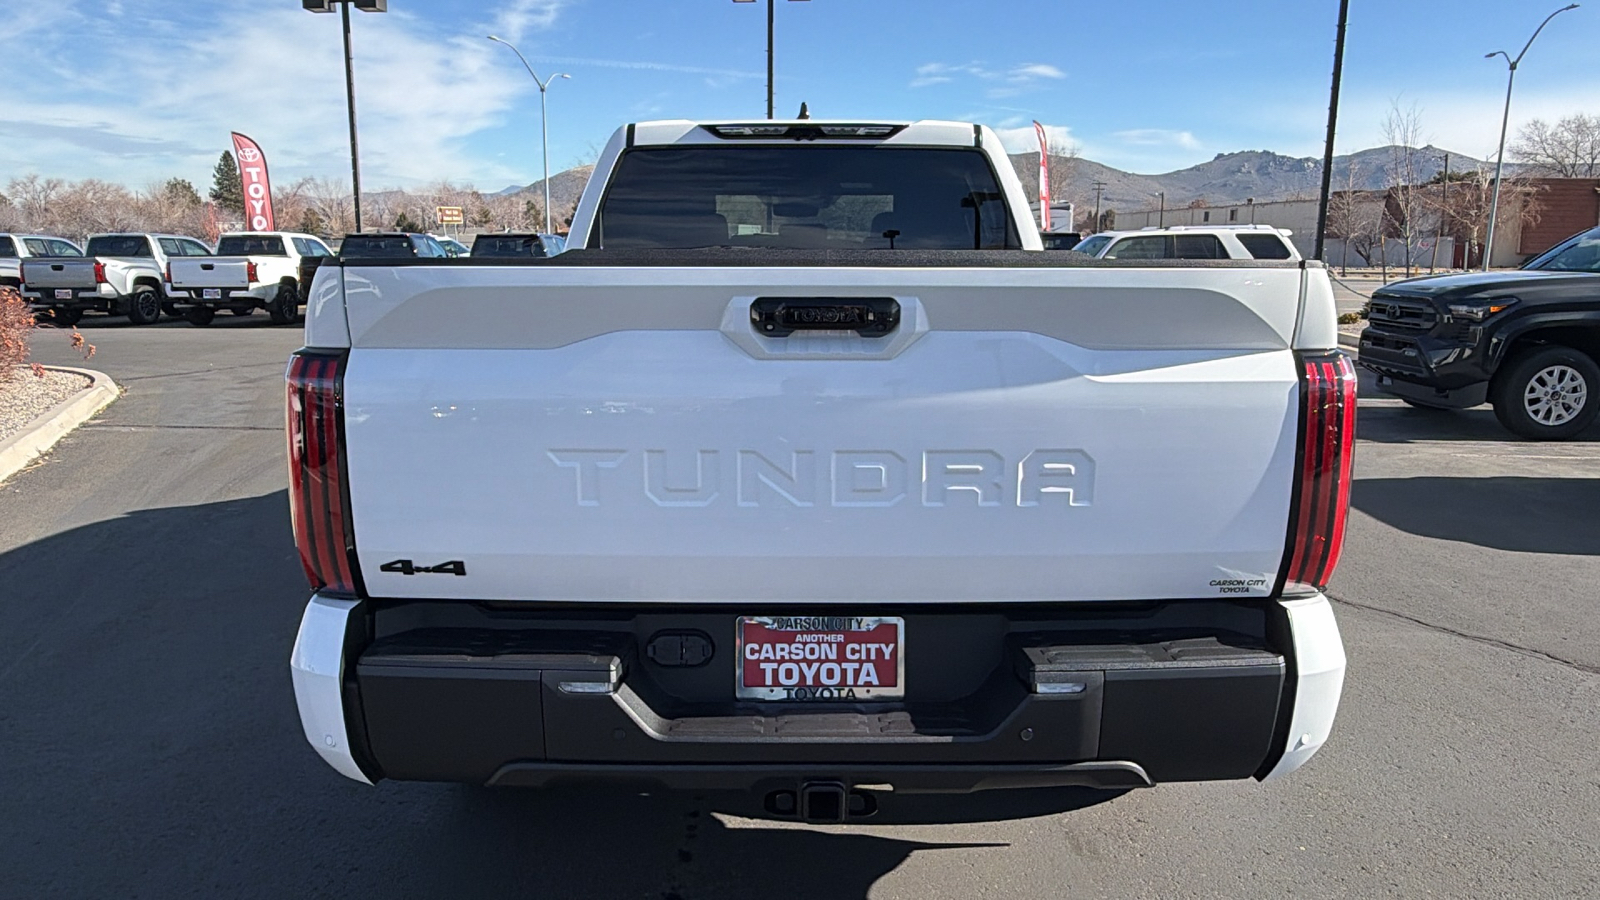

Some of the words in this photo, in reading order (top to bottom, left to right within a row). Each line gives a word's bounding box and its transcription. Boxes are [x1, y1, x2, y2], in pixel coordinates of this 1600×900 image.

[790, 307, 860, 323] TOYOTA
[546, 448, 1097, 507] TUNDRA
[1209, 579, 1246, 587] CARSON
[776, 617, 829, 630] CARSON
[834, 617, 864, 630] CITY
[795, 634, 845, 643] ANOTHER
[745, 643, 838, 660] CARSON
[845, 643, 895, 660] CITY
[760, 662, 880, 686] TOYOTA
[783, 687, 857, 701] TOYOTA
